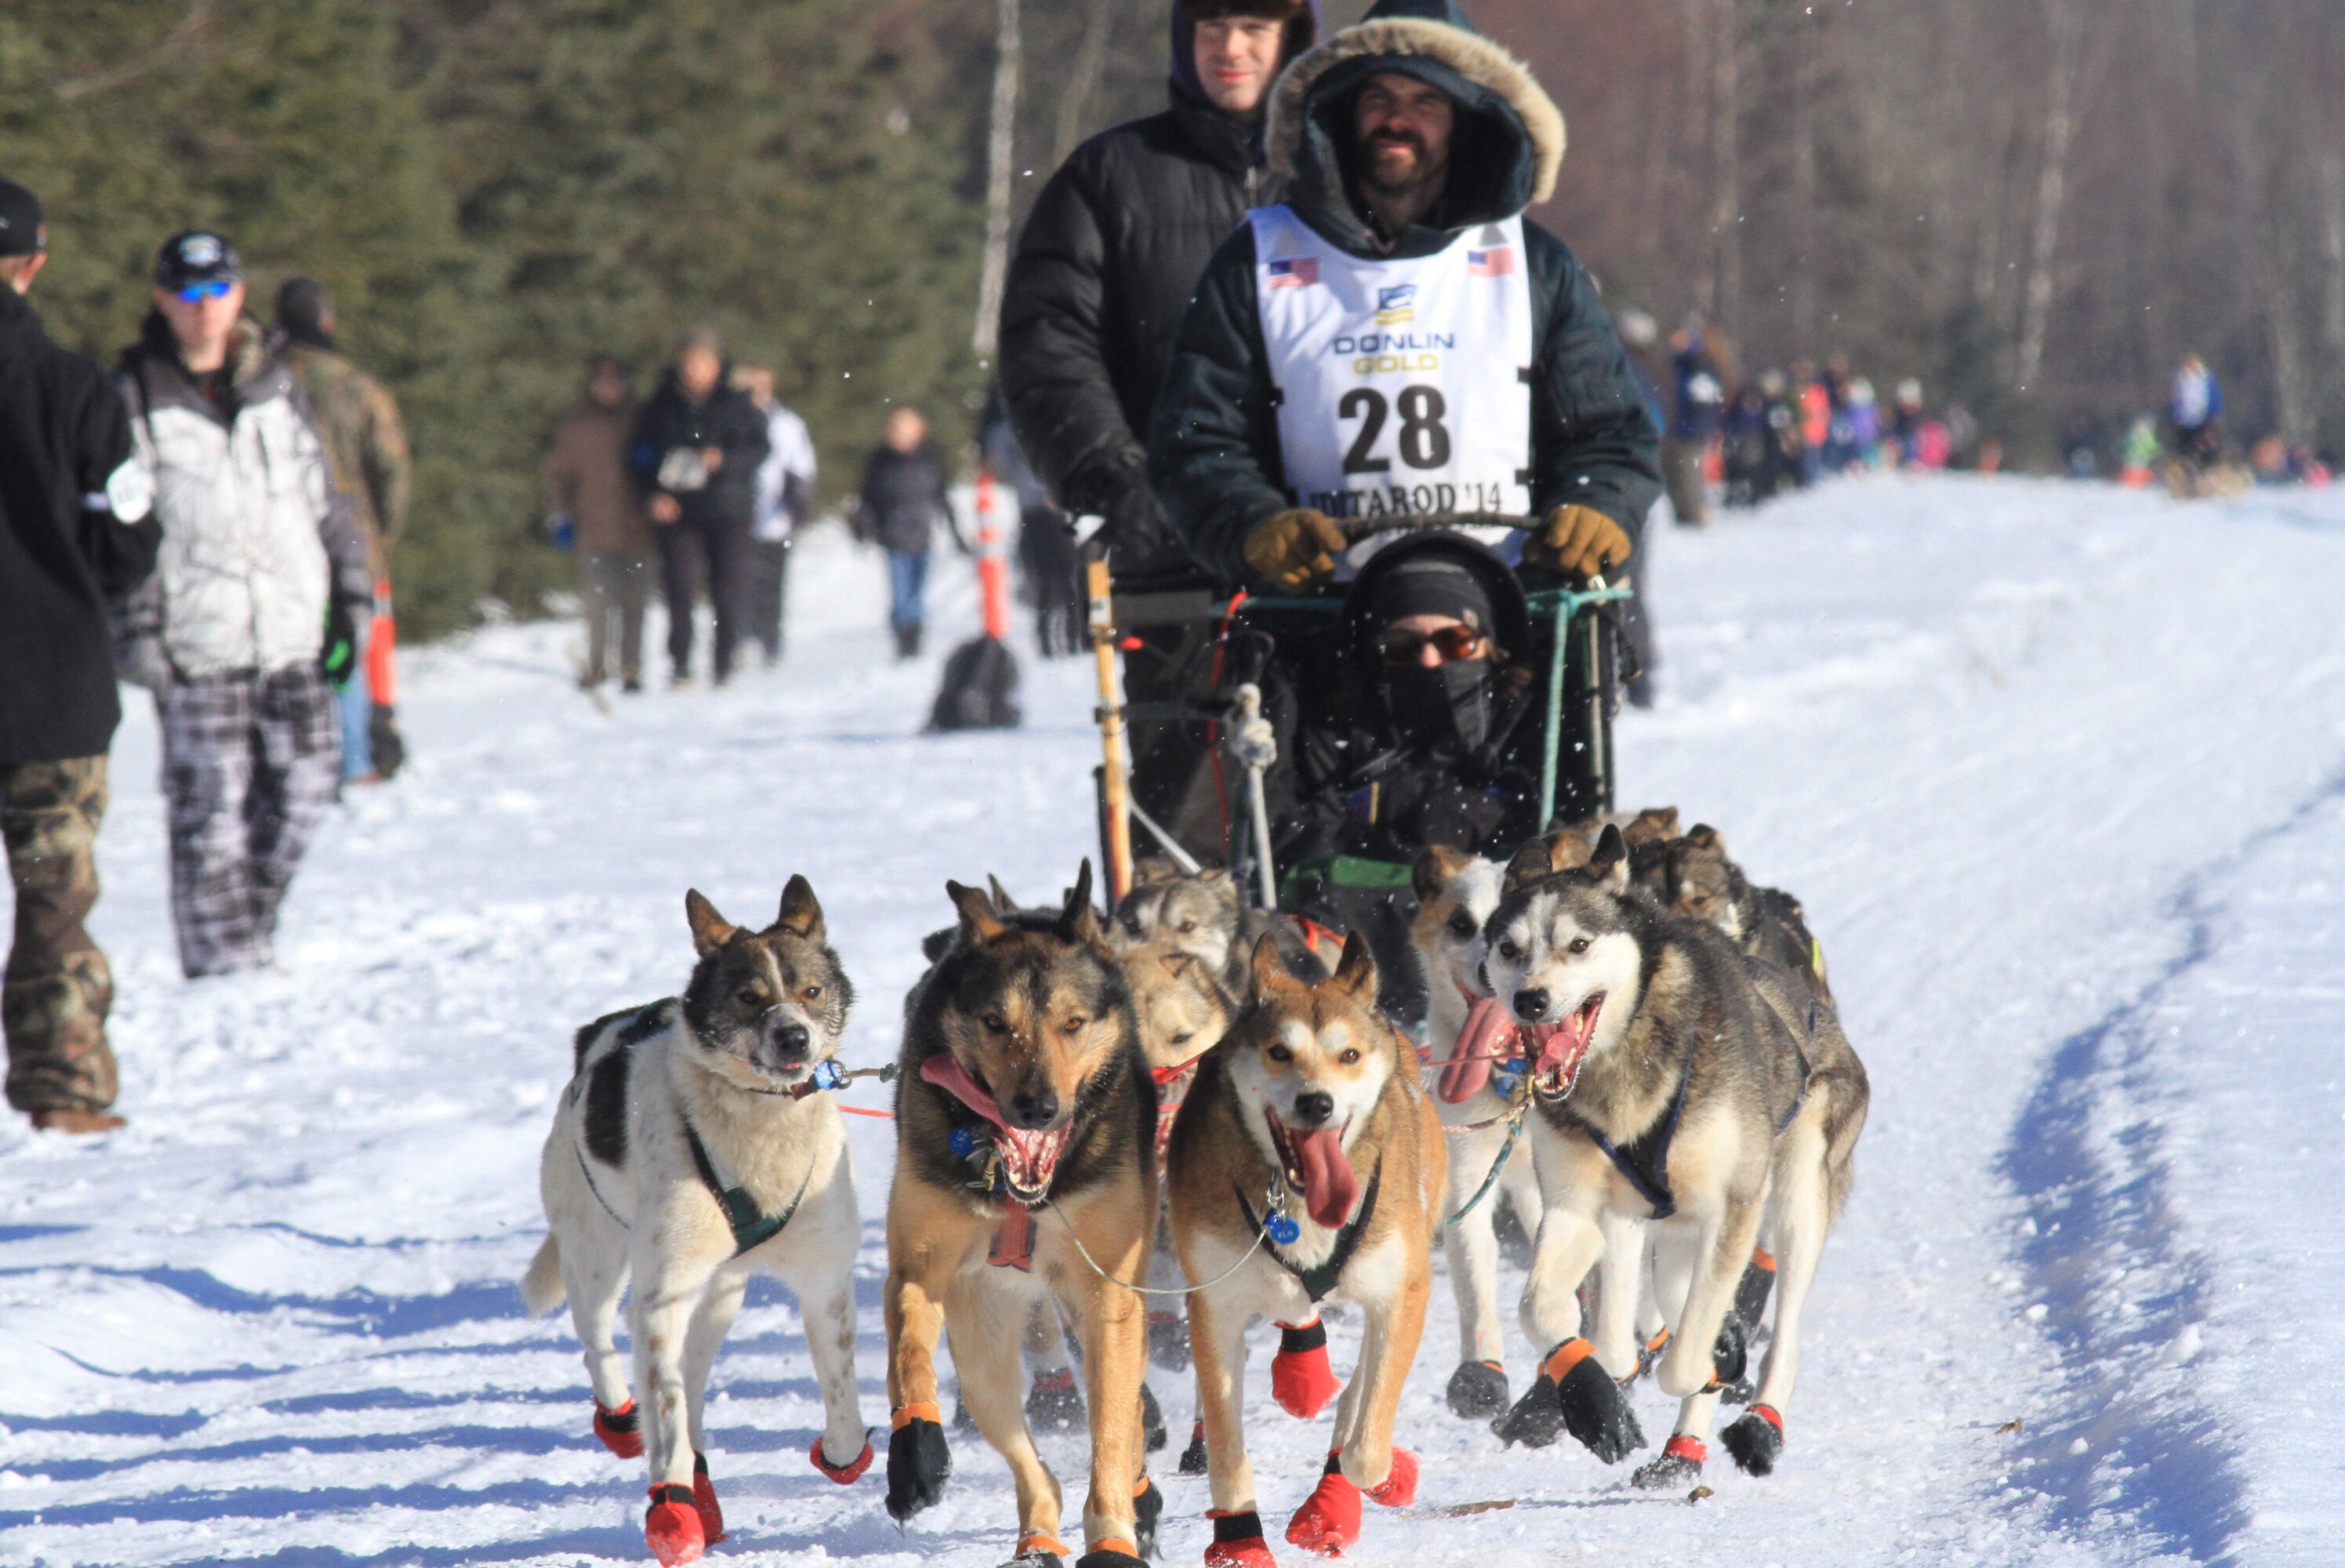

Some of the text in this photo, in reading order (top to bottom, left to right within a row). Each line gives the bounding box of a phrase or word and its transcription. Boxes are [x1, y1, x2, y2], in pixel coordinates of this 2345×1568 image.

[1334, 333, 1455, 354] DONLIN
[1353, 354, 1439, 375] GOLD
[1339, 383, 1450, 474] 28
